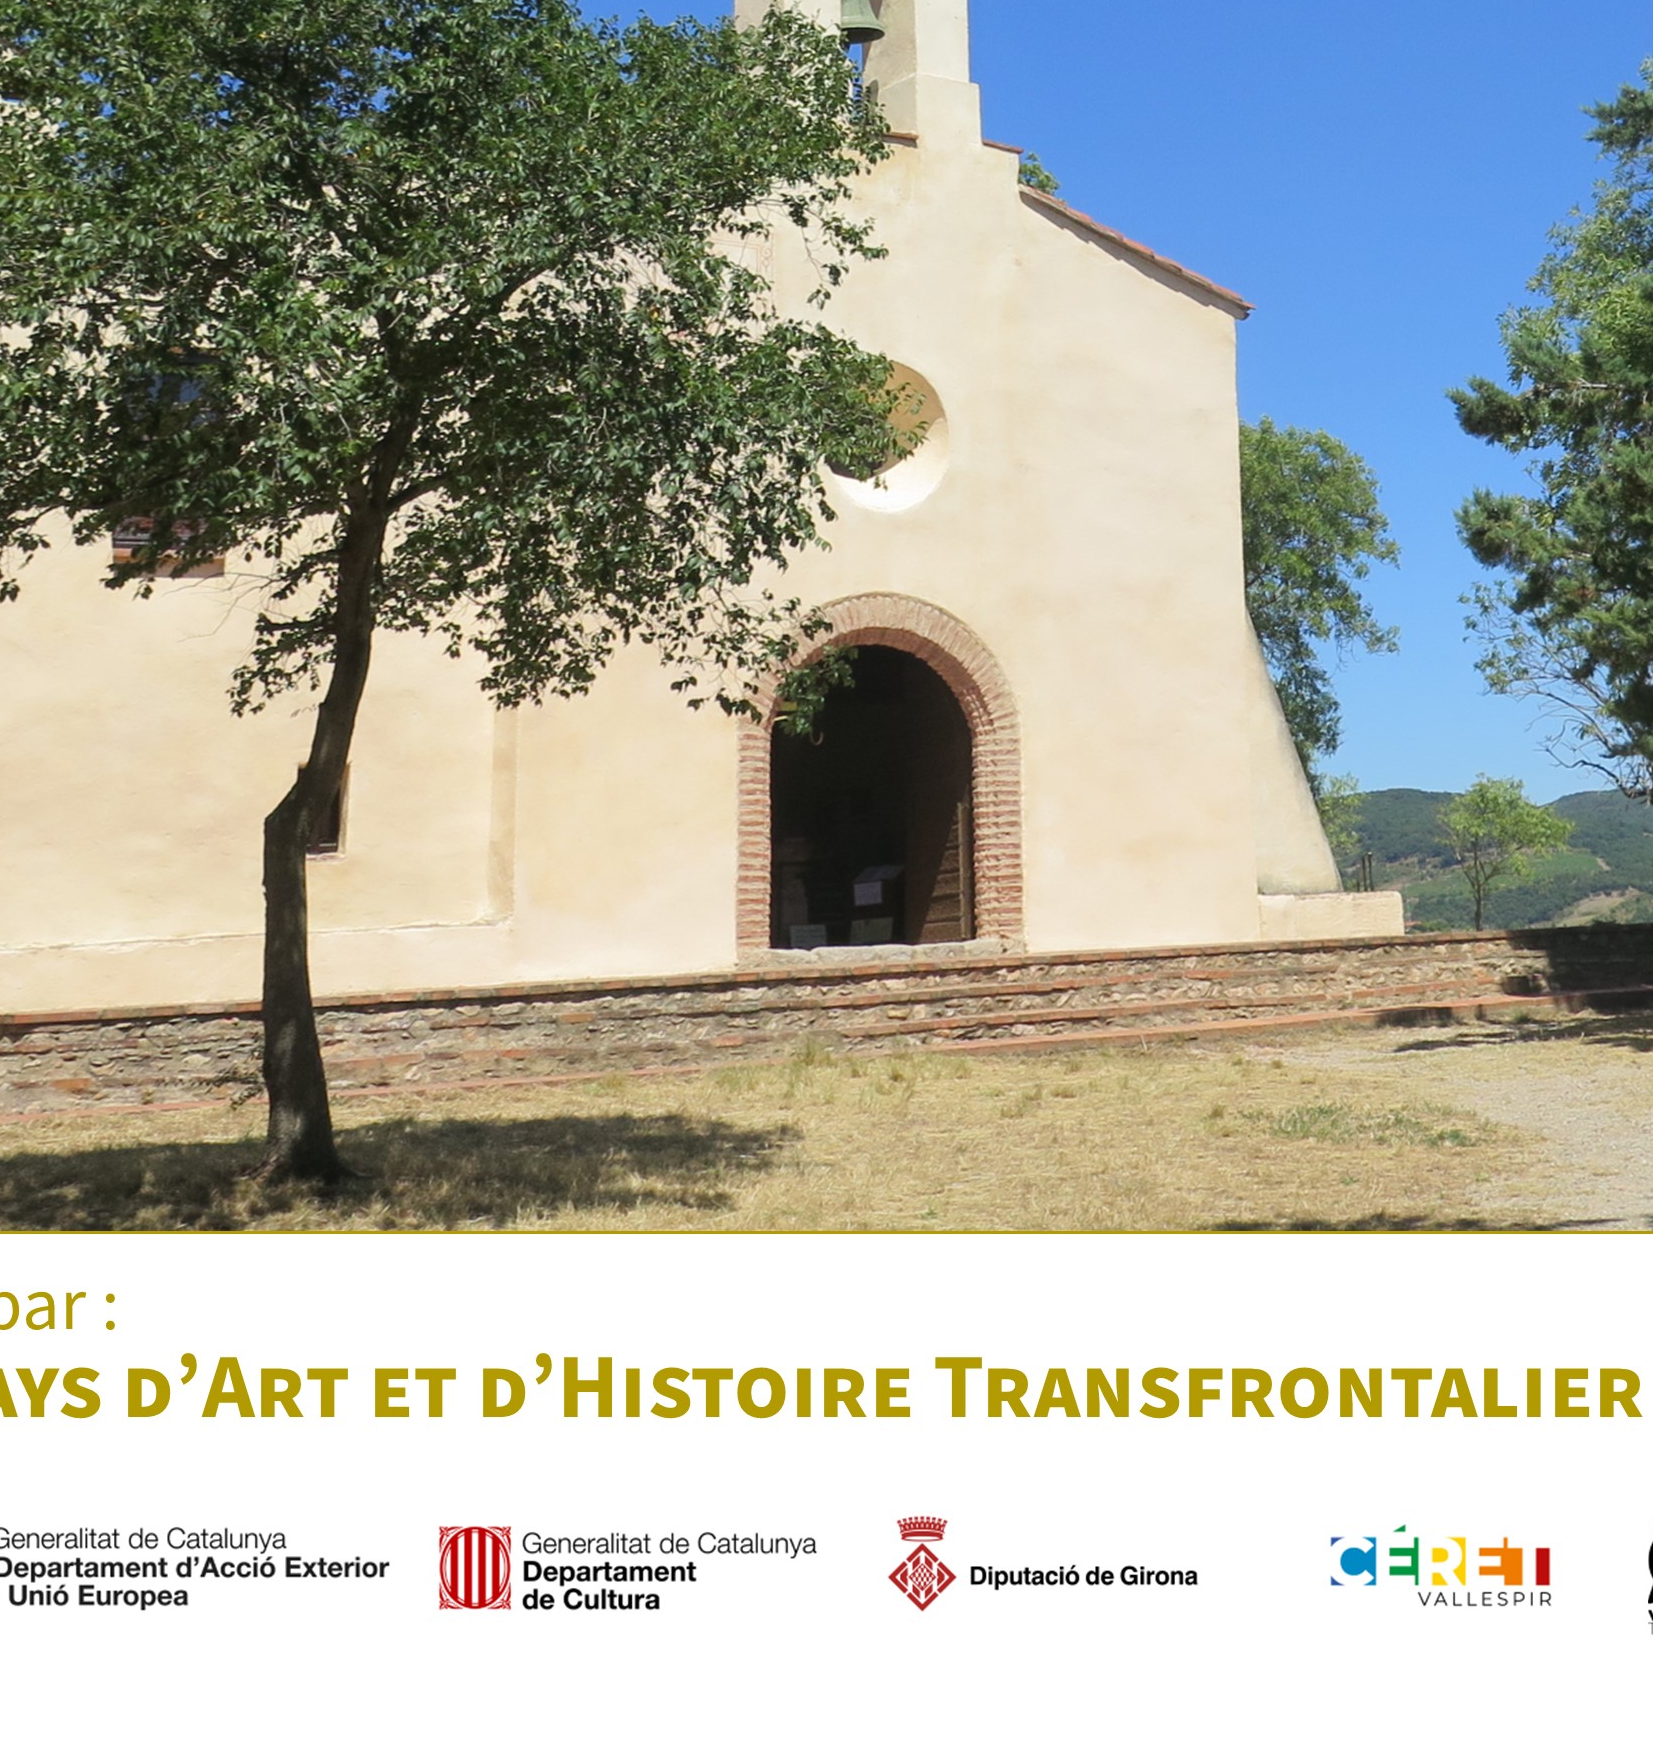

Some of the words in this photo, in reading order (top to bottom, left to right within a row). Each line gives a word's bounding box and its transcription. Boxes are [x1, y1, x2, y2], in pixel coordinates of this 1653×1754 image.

[129, 1528, 158, 1549] de
[167, 1527, 287, 1554] Catalunya
[523, 1532, 651, 1554] Generalitat
[660, 1533, 689, 1554] de
[698, 1532, 817, 1559] Catalunya
[176, 1556, 275, 1578] d’Acció
[286, 1557, 389, 1578] Exterior
[1330, 1524, 1550, 1586] CÉRET
[524, 1561, 696, 1586] Departament
[971, 1565, 1079, 1590] Diputació
[1086, 1566, 1114, 1585] de
[1120, 1566, 1197, 1585] Girona
[9, 1585, 68, 1606] Unió
[79, 1585, 188, 1610] Europea
[523, 1589, 554, 1610] de
[564, 1588, 659, 1610] Cultura
[1418, 1592, 1551, 1606] VALLESPIR
